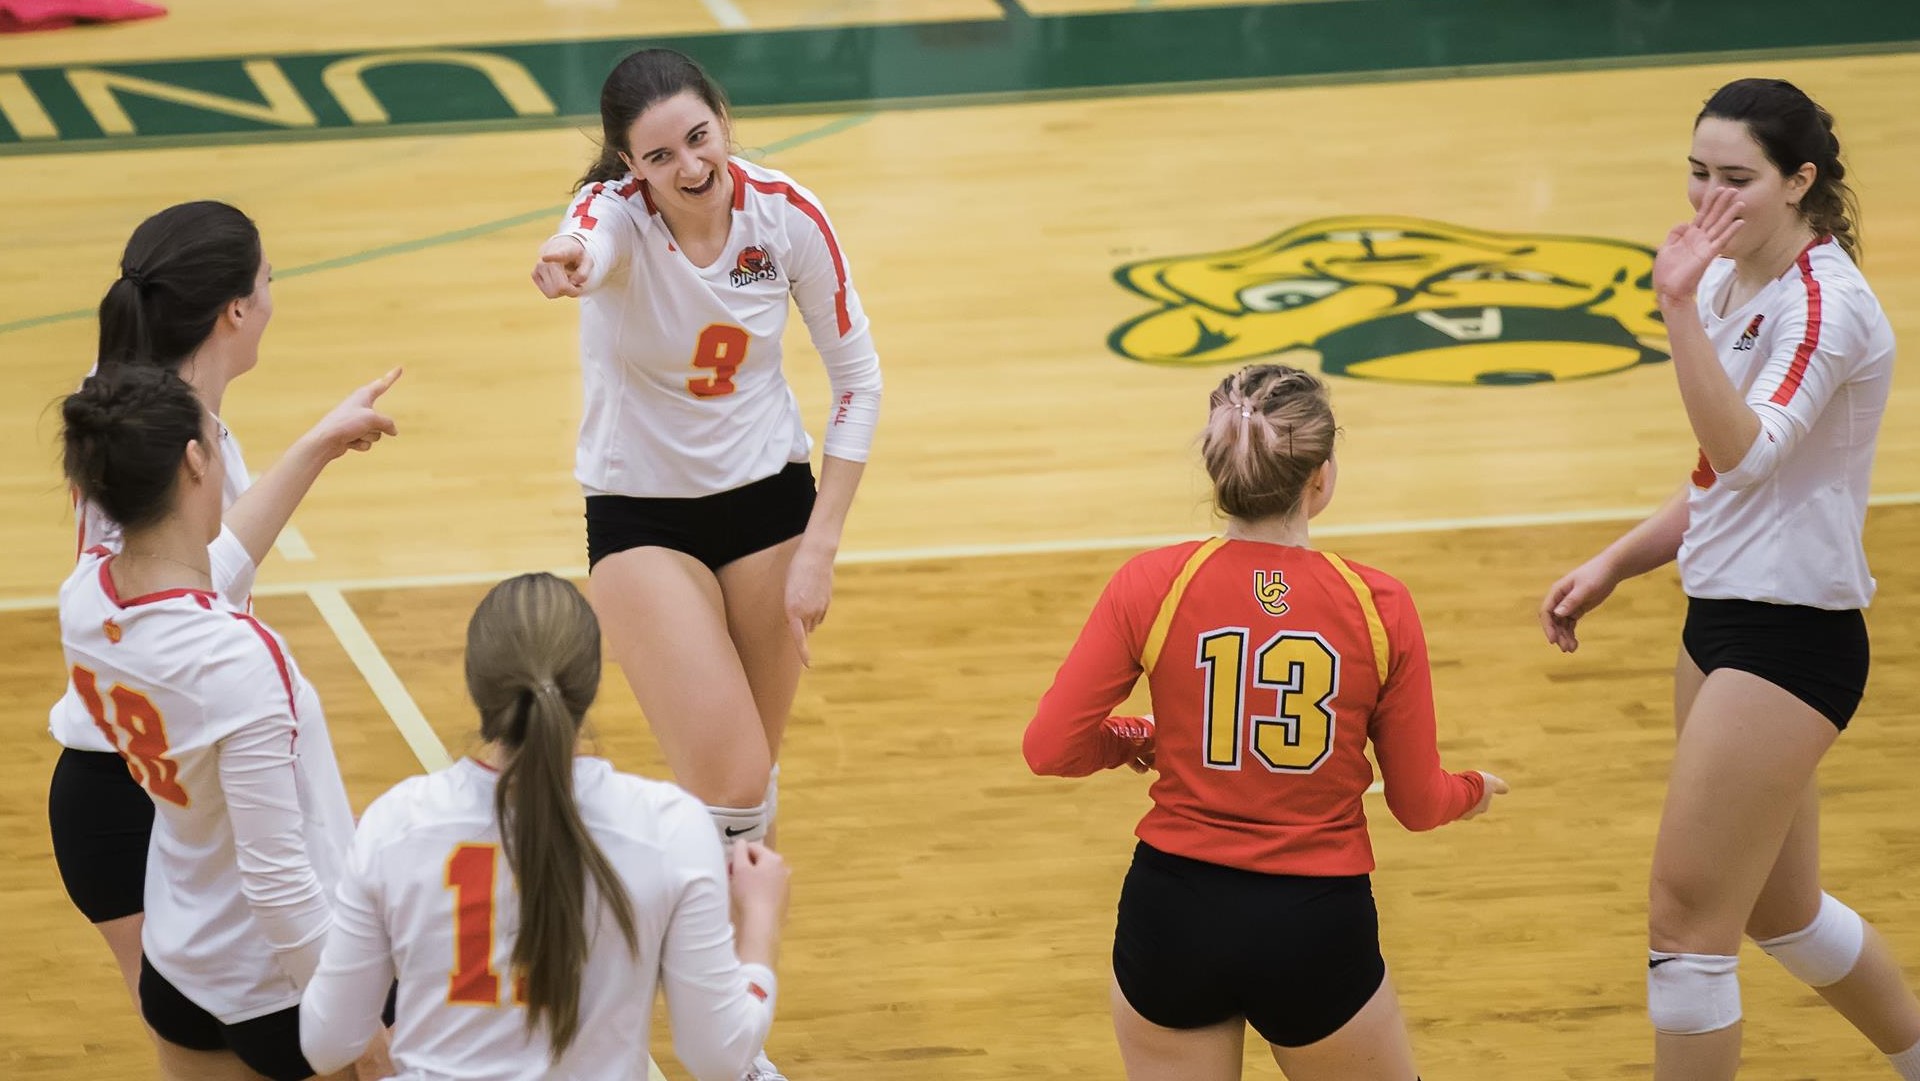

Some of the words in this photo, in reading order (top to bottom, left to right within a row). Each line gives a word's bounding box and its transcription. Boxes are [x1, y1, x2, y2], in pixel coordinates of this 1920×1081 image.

[729, 264, 777, 288] DINOS
[686, 322, 750, 399] 9
[1254, 570, 1291, 617] UC
[71, 663, 192, 811] 18
[1196, 626, 1341, 774] 13
[442, 842, 532, 1008] 1
